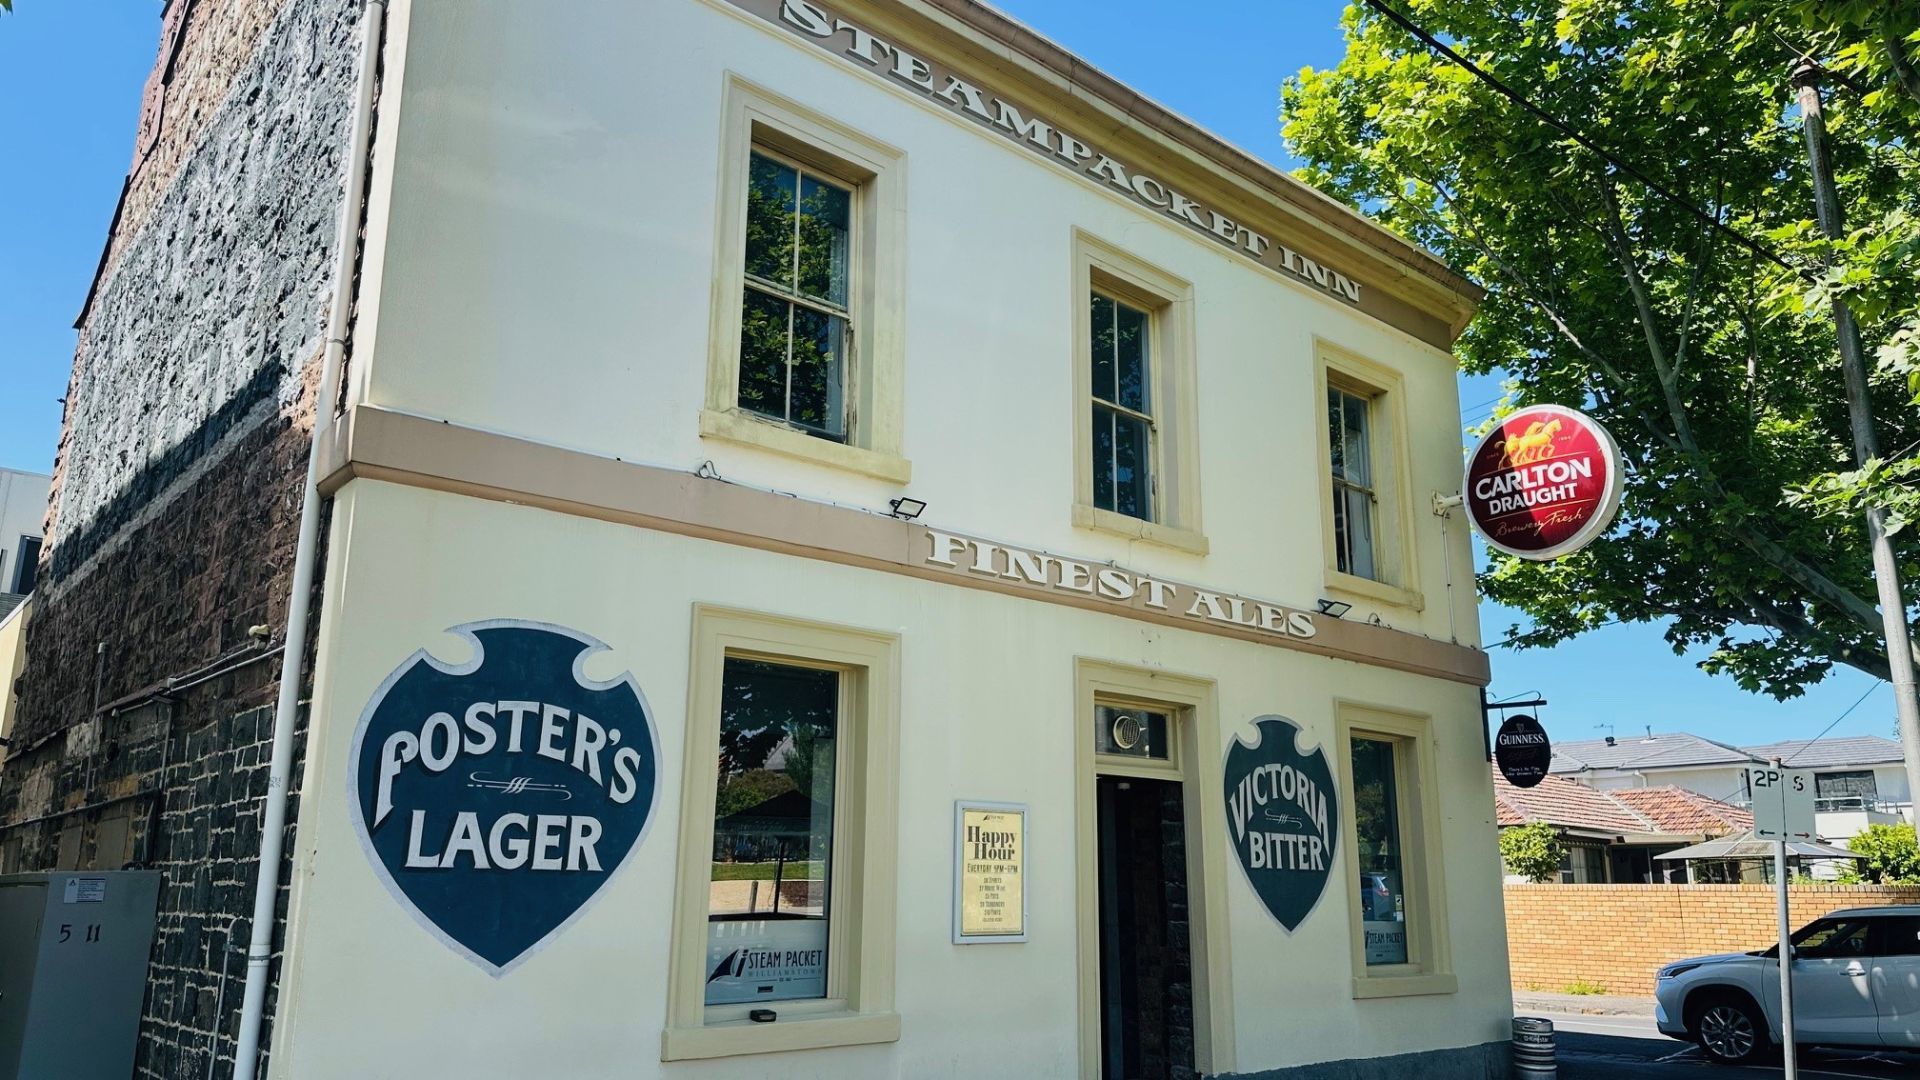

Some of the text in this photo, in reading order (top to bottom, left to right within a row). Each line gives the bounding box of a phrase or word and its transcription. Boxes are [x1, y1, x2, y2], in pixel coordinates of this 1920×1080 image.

[1280, 246, 1362, 303] INN
[1475, 457, 1593, 500] CARLTON
[1489, 483, 1578, 515] DRAUGHT
[1495, 507, 1585, 537] Brewery Fresh
[926, 531, 1317, 639] FINEST ALES
[1499, 733, 1544, 745] GUINNESS
[373, 700, 642, 829] FOSTER'S
[1753, 770, 1779, 788] 2P
[1229, 763, 1331, 858] VICTORIA
[405, 809, 604, 871] LAGER
[967, 825, 1017, 848] Happy
[974, 843, 1015, 860] Hour
[1248, 831, 1325, 872] BITTER
[58, 923, 101, 943] 5 11
[748, 950, 822, 968] STEAM PACKET
